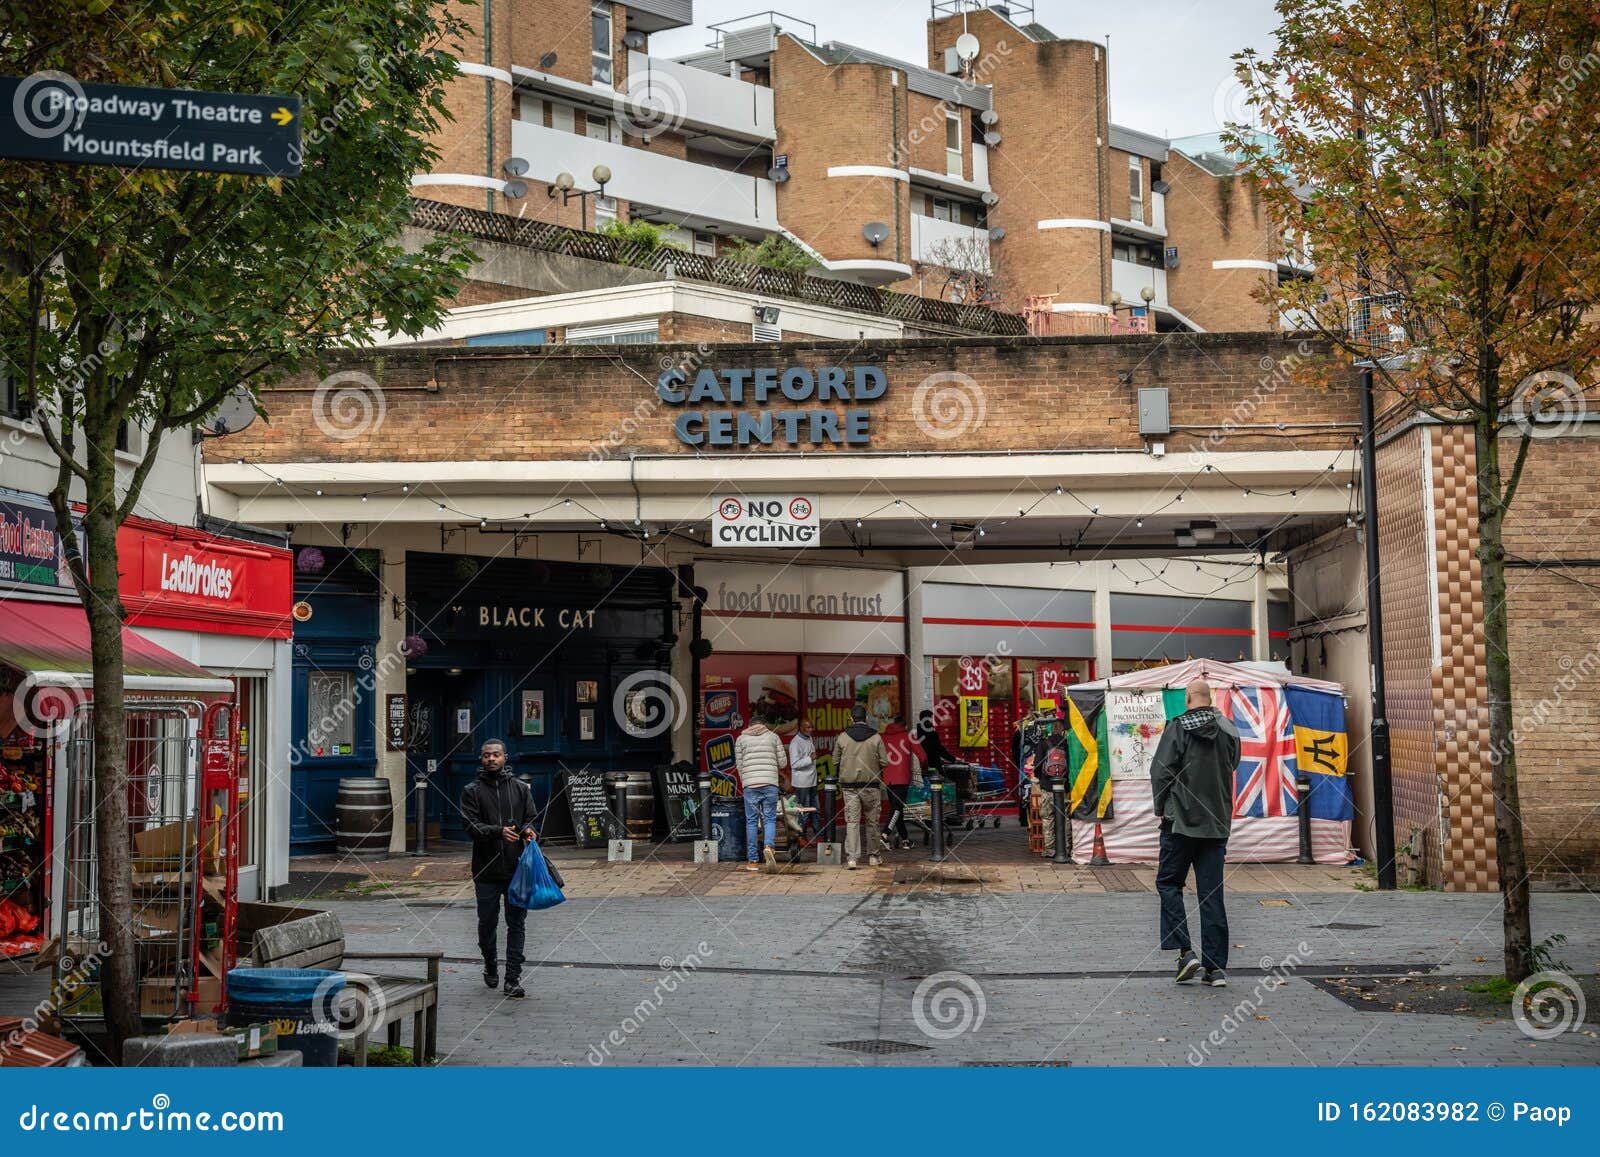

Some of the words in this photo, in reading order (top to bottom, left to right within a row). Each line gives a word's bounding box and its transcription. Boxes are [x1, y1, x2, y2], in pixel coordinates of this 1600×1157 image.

[49, 91, 165, 121] Broadway
[172, 99, 262, 124] Theatre
[63, 133, 205, 162] Mountsfield
[212, 144, 262, 165] Park
[656, 366, 888, 403] CATFORD
[675, 410, 870, 444] CENTRE
[748, 501, 782, 518] NO
[23, 517, 55, 560] Centre
[719, 525, 813, 542] CYCLING
[161, 552, 232, 599] Ladbrokes
[718, 582, 762, 611] food
[767, 592, 800, 618] you
[806, 592, 838, 615] can
[842, 591, 882, 616] trust
[480, 606, 545, 627] BLACK
[559, 609, 596, 629] CAT
[807, 675, 851, 703] great
[966, 665, 983, 691] £3
[1043, 670, 1058, 694] £2
[1114, 695, 1133, 705] JAH
[1124, 705, 1154, 713] MUSIC
[807, 704, 852, 731] value
[1113, 713, 1164, 721] PROMOTIONS
[709, 741, 732, 760] WIN
[568, 775, 592, 785] Black
[665, 772, 694, 783] LIVE
[666, 784, 696, 794] MUSIC
[710, 777, 734, 798] SAVE
